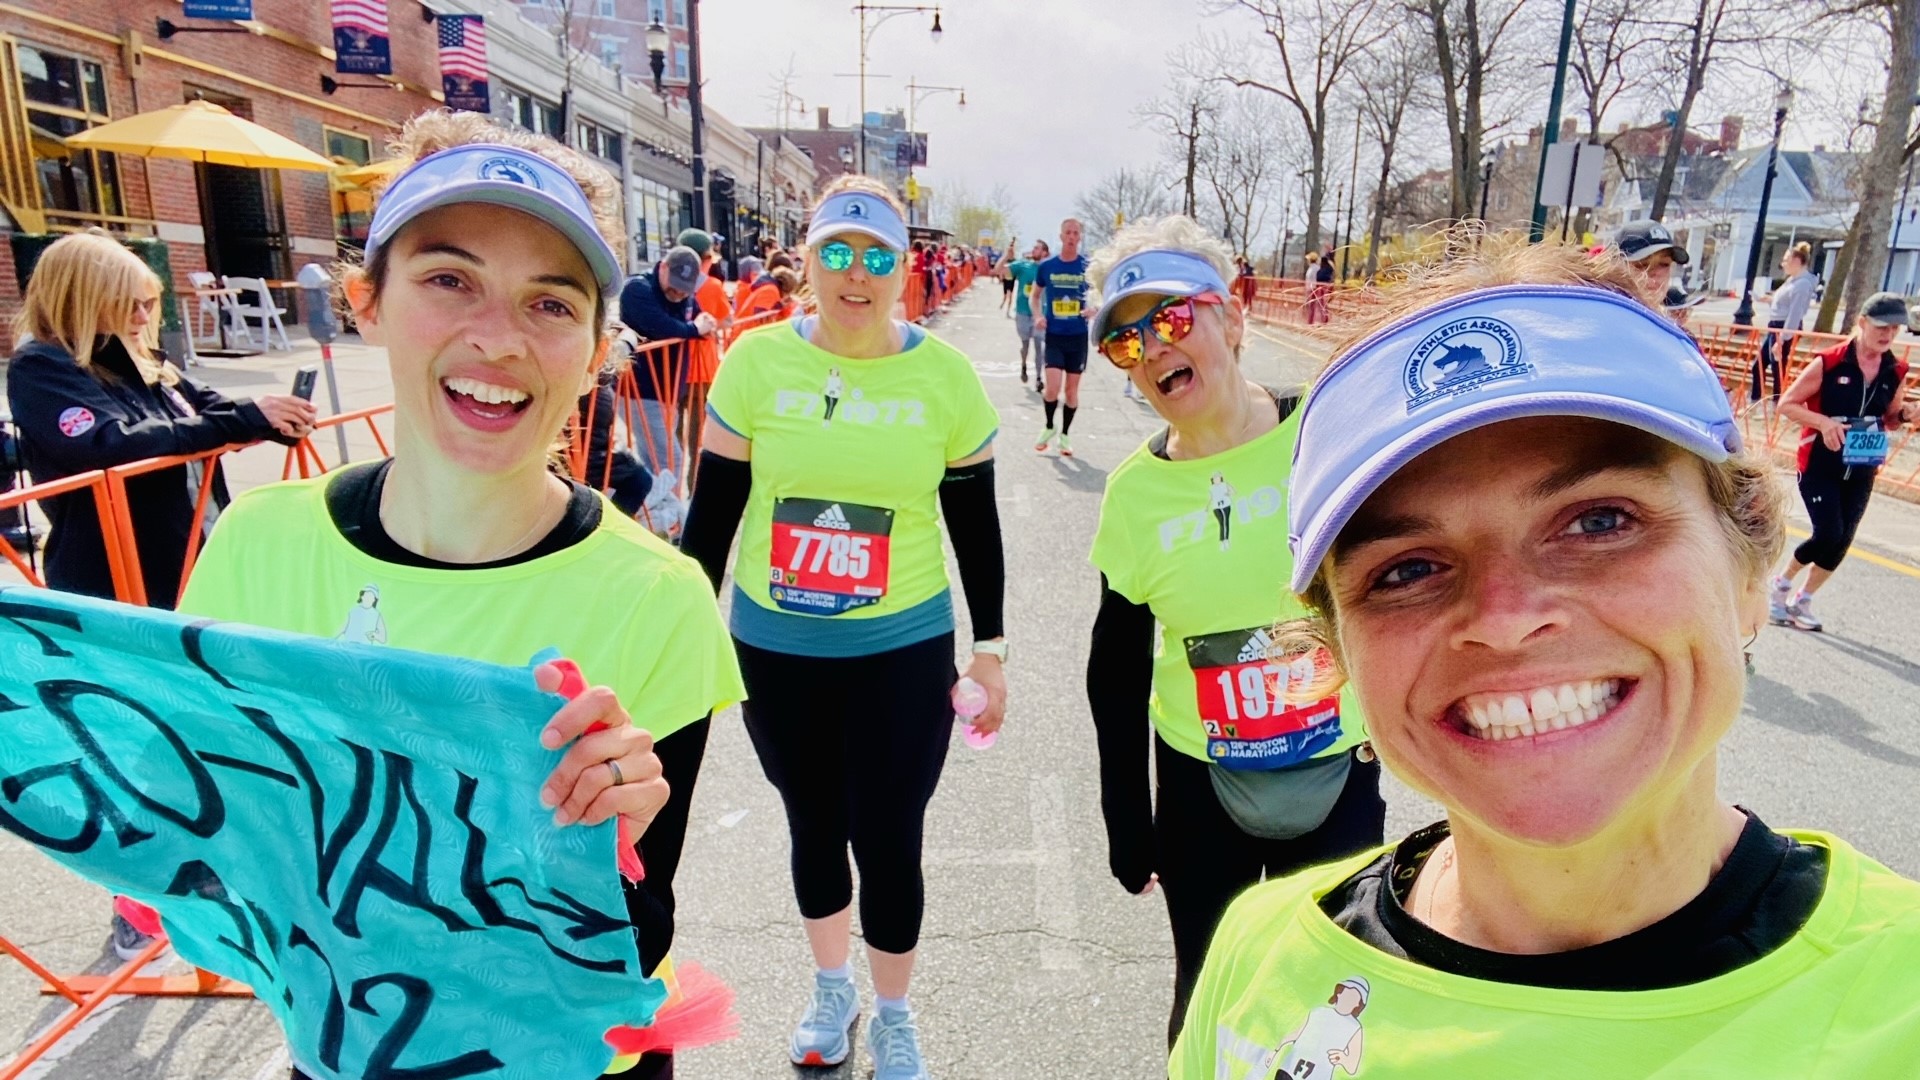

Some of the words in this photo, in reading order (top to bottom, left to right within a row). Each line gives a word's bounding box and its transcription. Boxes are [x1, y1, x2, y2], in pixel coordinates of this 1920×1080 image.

[1417, 322, 1467, 358] ATHLETIC
[1469, 320, 1517, 364] ASSOCIATION
[776, 390, 819, 417] F7
[842, 401, 925, 425] 1972
[1849, 433, 1886, 450] 23627
[1158, 510, 1207, 552] F7
[1237, 477, 1290, 524] 19
[813, 518, 851, 531] adidas
[789, 528, 872, 580] 7785
[771, 569, 780, 580] 8
[786, 574, 796, 585] V
[786, 596, 836, 609] MARATHON
[1206, 722, 1218, 734] 2
[1225, 727, 1235, 738] V
[1249, 736, 1287, 750] BOSTON
[1230, 745, 1289, 758] MARATHON
[1293, 1058, 1316, 1080] F7
